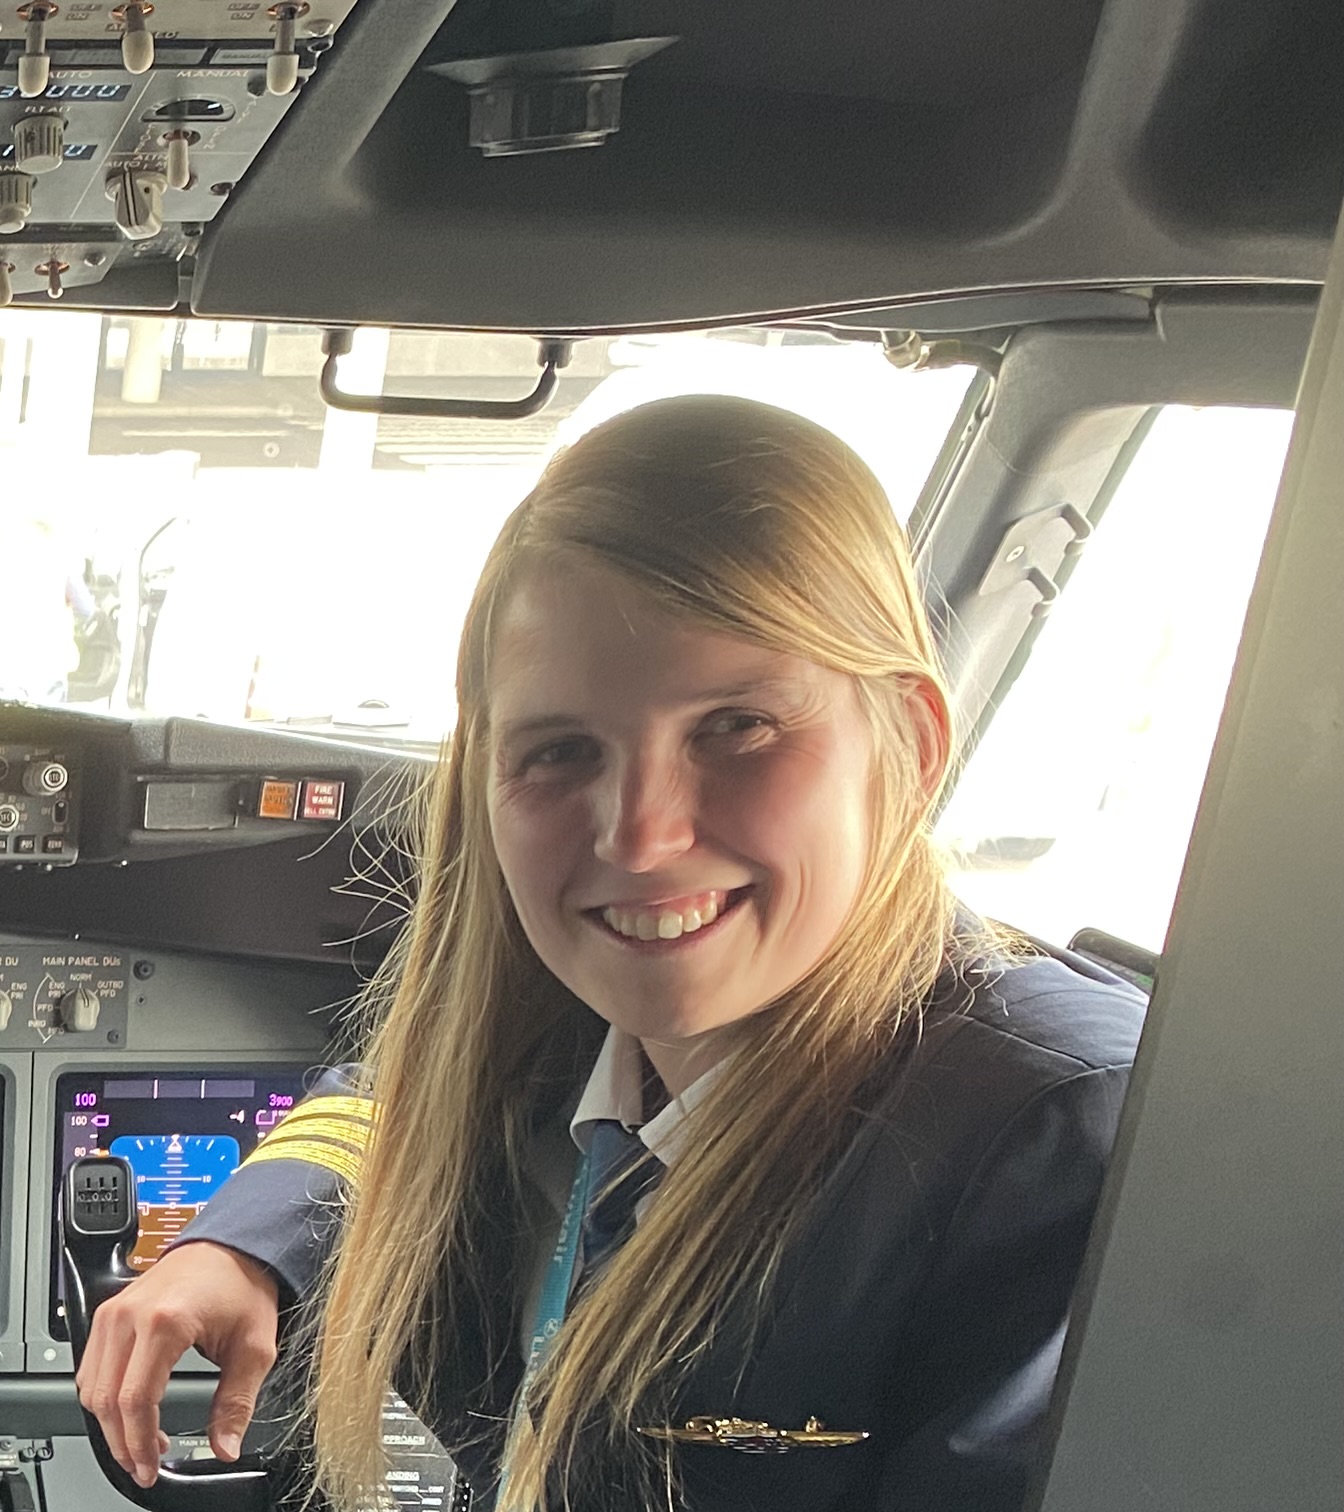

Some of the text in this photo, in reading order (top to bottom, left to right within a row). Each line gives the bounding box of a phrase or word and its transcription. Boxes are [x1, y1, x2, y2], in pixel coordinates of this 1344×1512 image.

[315, 785, 333, 794] FIRE
[312, 796, 333, 804] WARN
[3, 957, 18, 966] DU
[42, 957, 63, 966] MAIN
[67, 957, 99, 966] PANEL
[70, 973, 92, 981] NORM
[75, 1094, 96, 1106] 100
[269, 1094, 293, 1106] 3900
[71, 1117, 87, 1126] 100
[75, 1147, 85, 1156] 80
